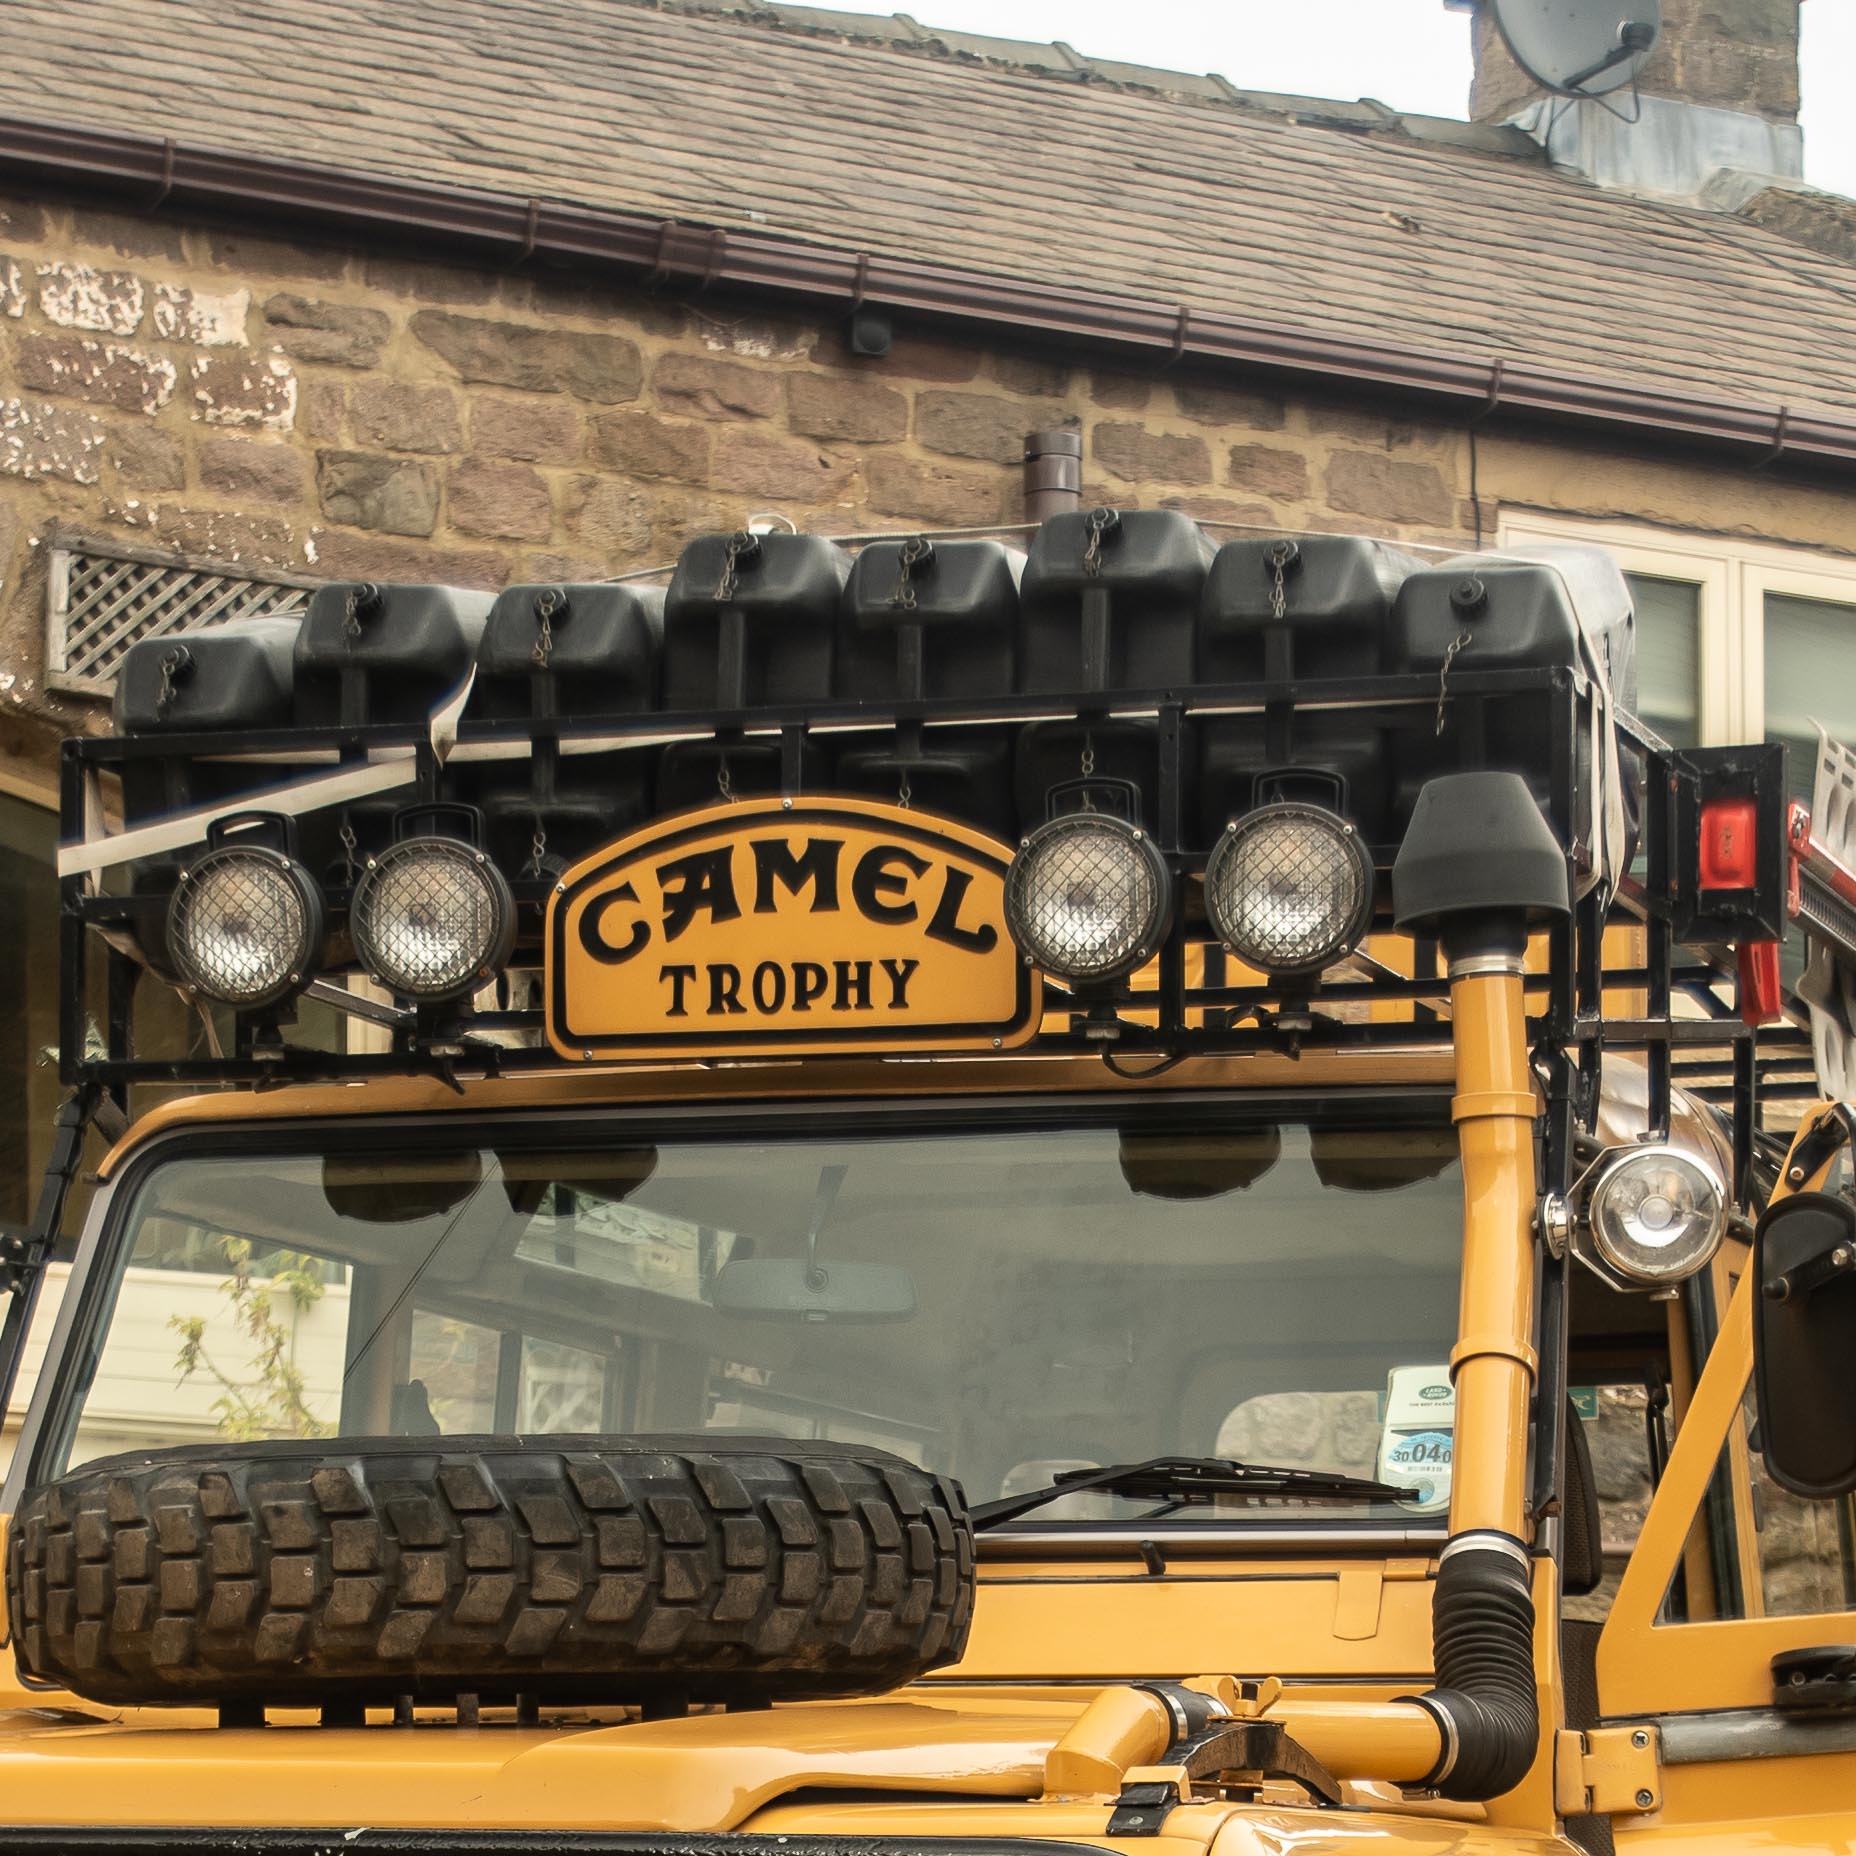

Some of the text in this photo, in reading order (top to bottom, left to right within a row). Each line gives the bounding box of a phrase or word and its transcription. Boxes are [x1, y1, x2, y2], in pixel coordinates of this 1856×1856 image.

[576, 836, 1001, 966] CAMEL
[659, 958, 920, 1017] TROPHY
[1392, 1450, 1410, 1462] 30
[1412, 1443, 1441, 1463] 04
